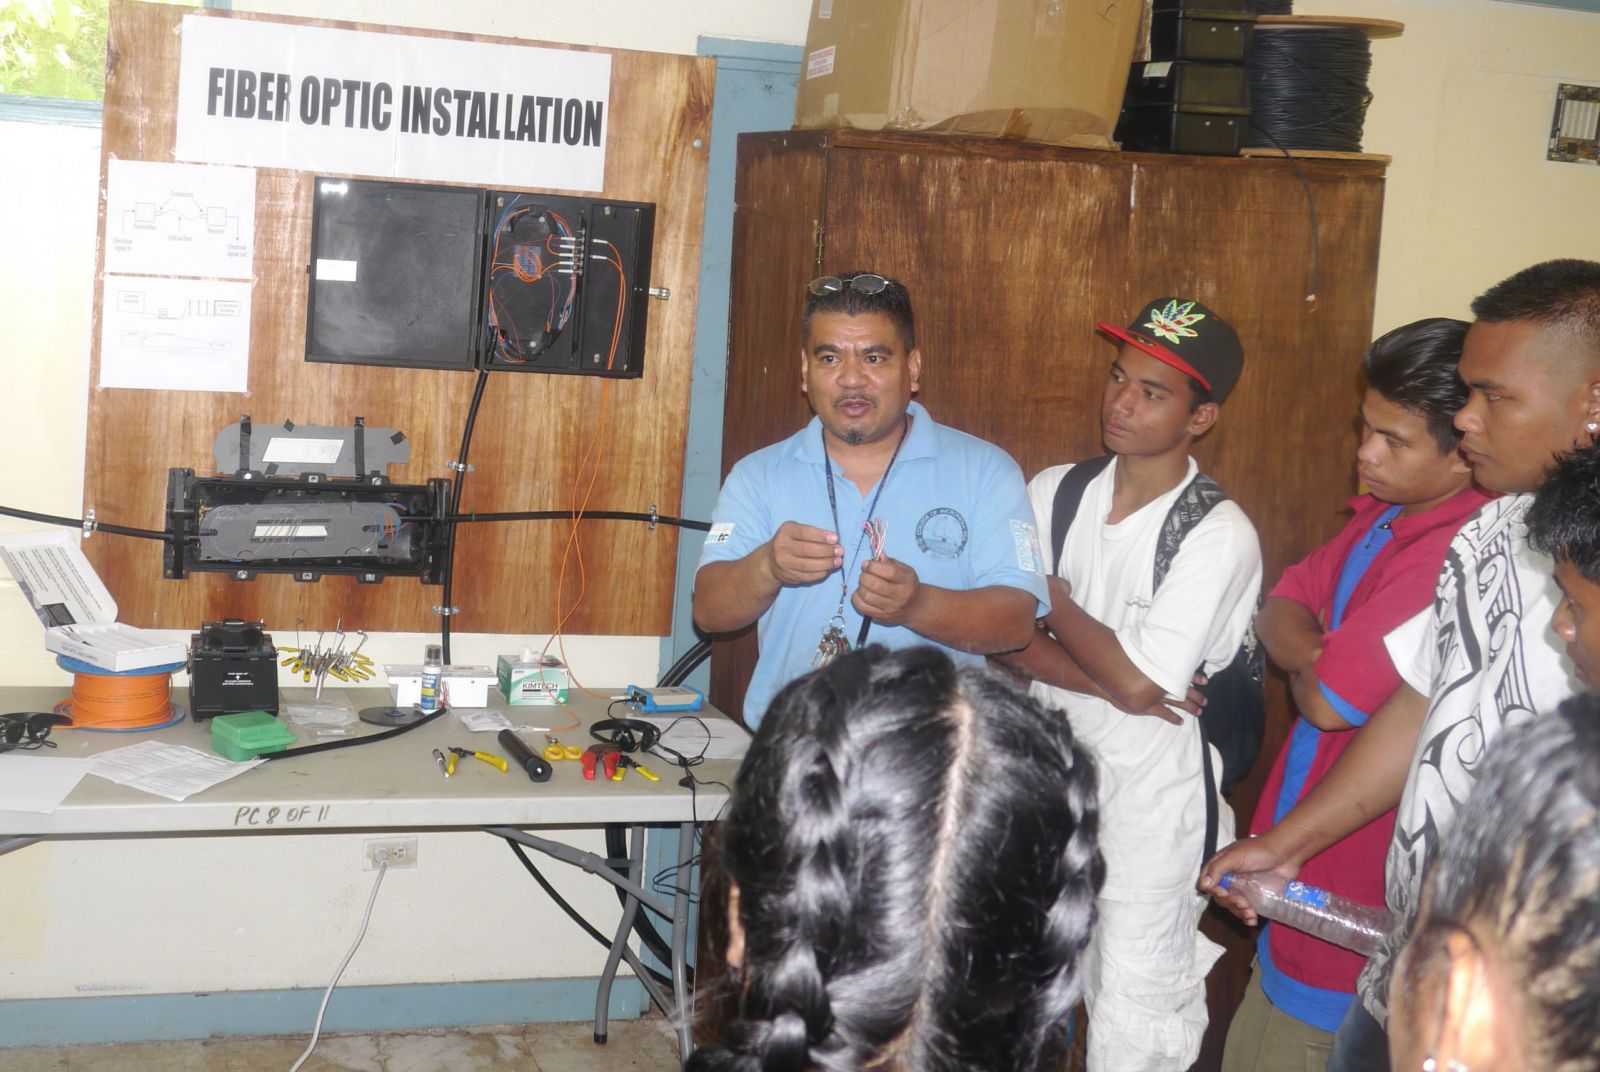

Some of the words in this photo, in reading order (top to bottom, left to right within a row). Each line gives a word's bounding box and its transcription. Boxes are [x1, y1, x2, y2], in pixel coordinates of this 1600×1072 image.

[206, 67, 292, 122] FIBER
[299, 75, 393, 132] OPTIC
[400, 84, 604, 147] INSTALLATION
[234, 805, 260, 826] PC
[266, 806, 281, 825] 8
[286, 805, 312, 822] OF
